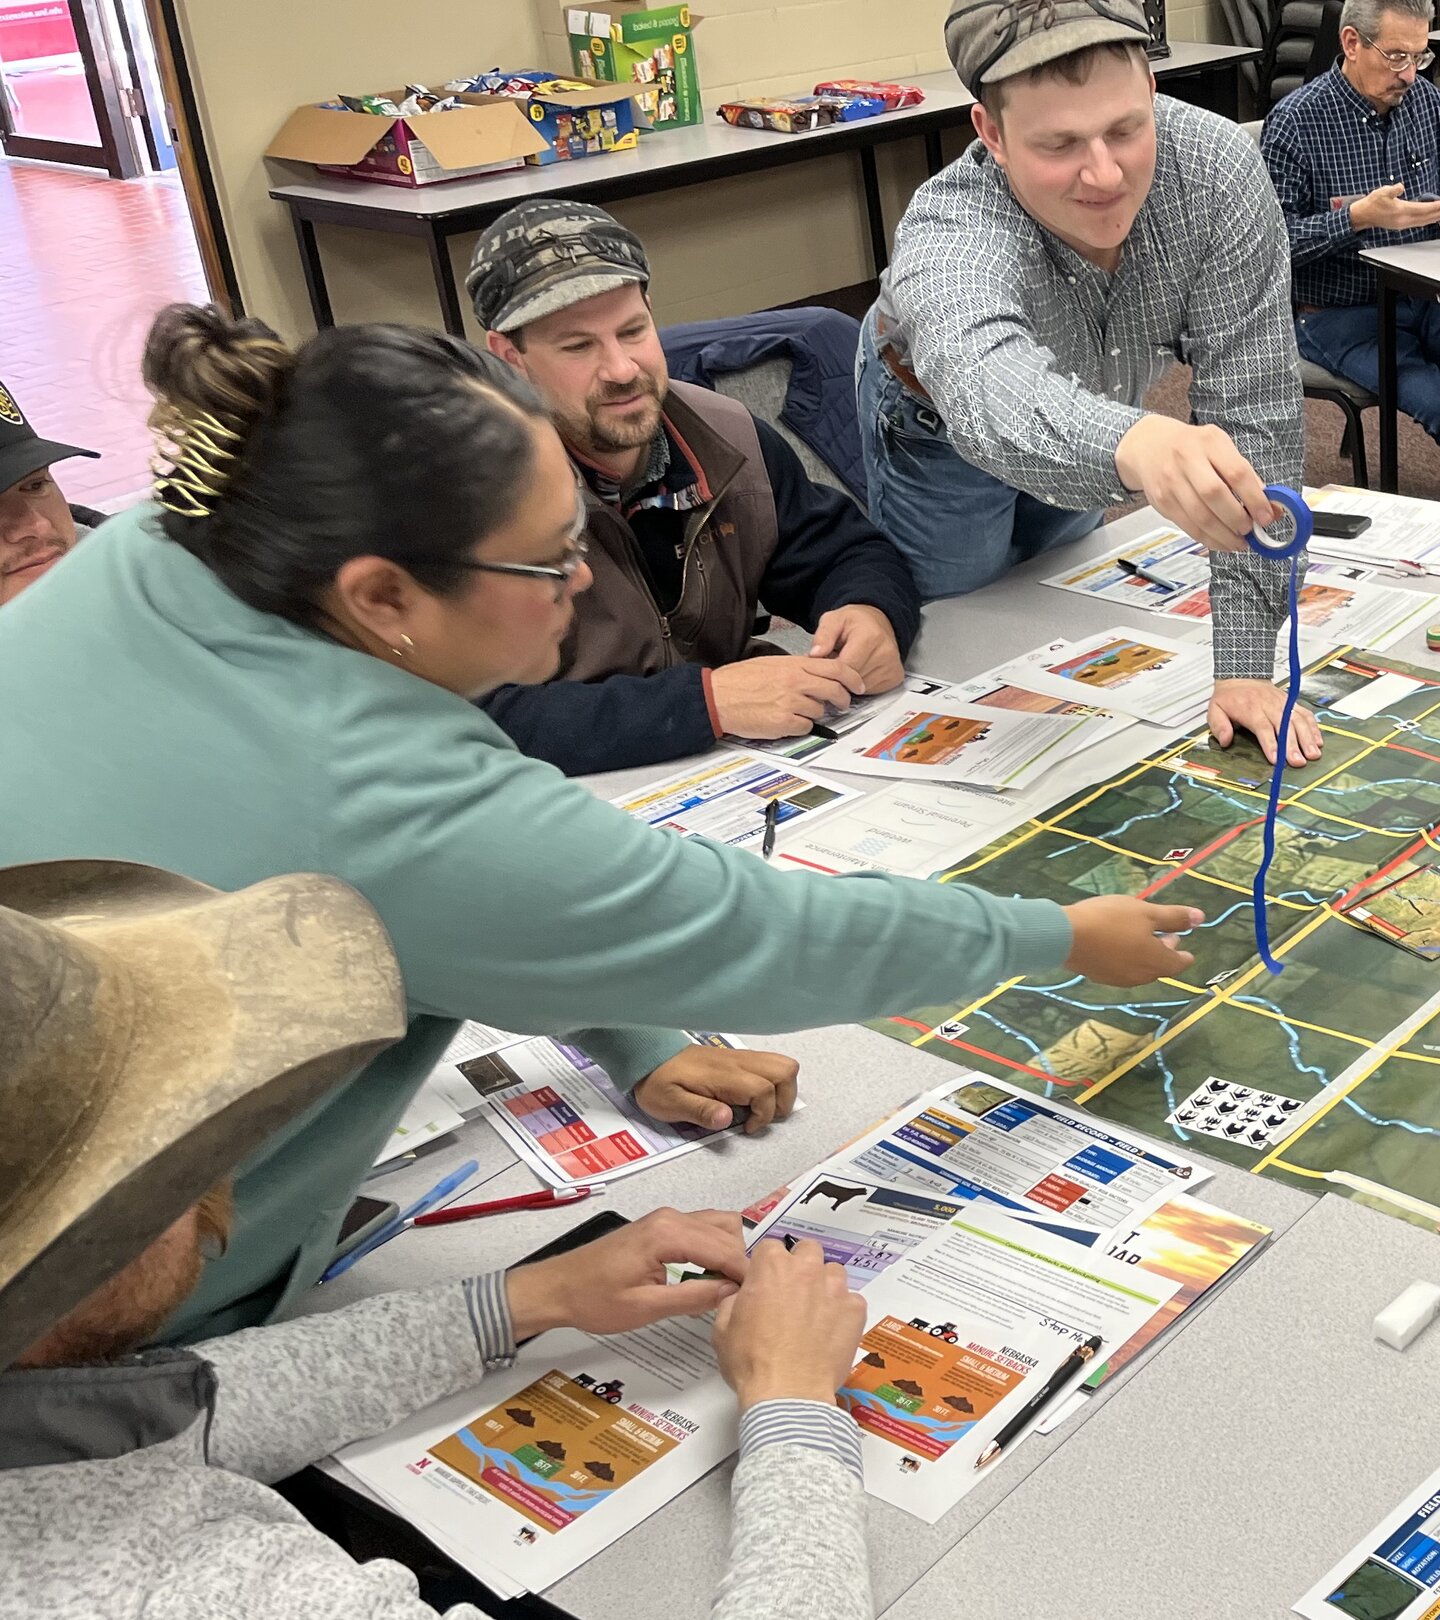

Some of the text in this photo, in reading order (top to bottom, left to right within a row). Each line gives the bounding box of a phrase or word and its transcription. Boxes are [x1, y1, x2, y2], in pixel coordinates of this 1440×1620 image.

[893, 800, 924, 816] Stream
[865, 827, 913, 844] Wetland
[1052, 1113, 1074, 1127] FIELD
[1074, 1120, 1108, 1141] RECORD
[1114, 1140, 1138, 1154] FIELD
[1004, 1241, 1101, 1284] Considering Setbacks and Stockpiling
[1039, 1318, 1069, 1335] Stop
[959, 1353, 982, 1369] SMALL
[986, 1365, 1010, 1381] MEDIUM
[965, 1341, 996, 1362] MANURE
[994, 1352, 1032, 1375] SETBACKS
[999, 1344, 1039, 1367] NEBRASKA
[616, 1417, 638, 1433] SMALL
[639, 1429, 664, 1447] MEDIUM
[627, 1403, 690, 1441] MANURE SETBACKS
[660, 1408, 700, 1434] NEBRASKA
[416, 1457, 431, 1469] N
[1391, 1551, 1406, 1564] SIZE:
[1401, 1555, 1416, 1569] SOIL:
[1411, 1549, 1439, 1576] ROTATION:
